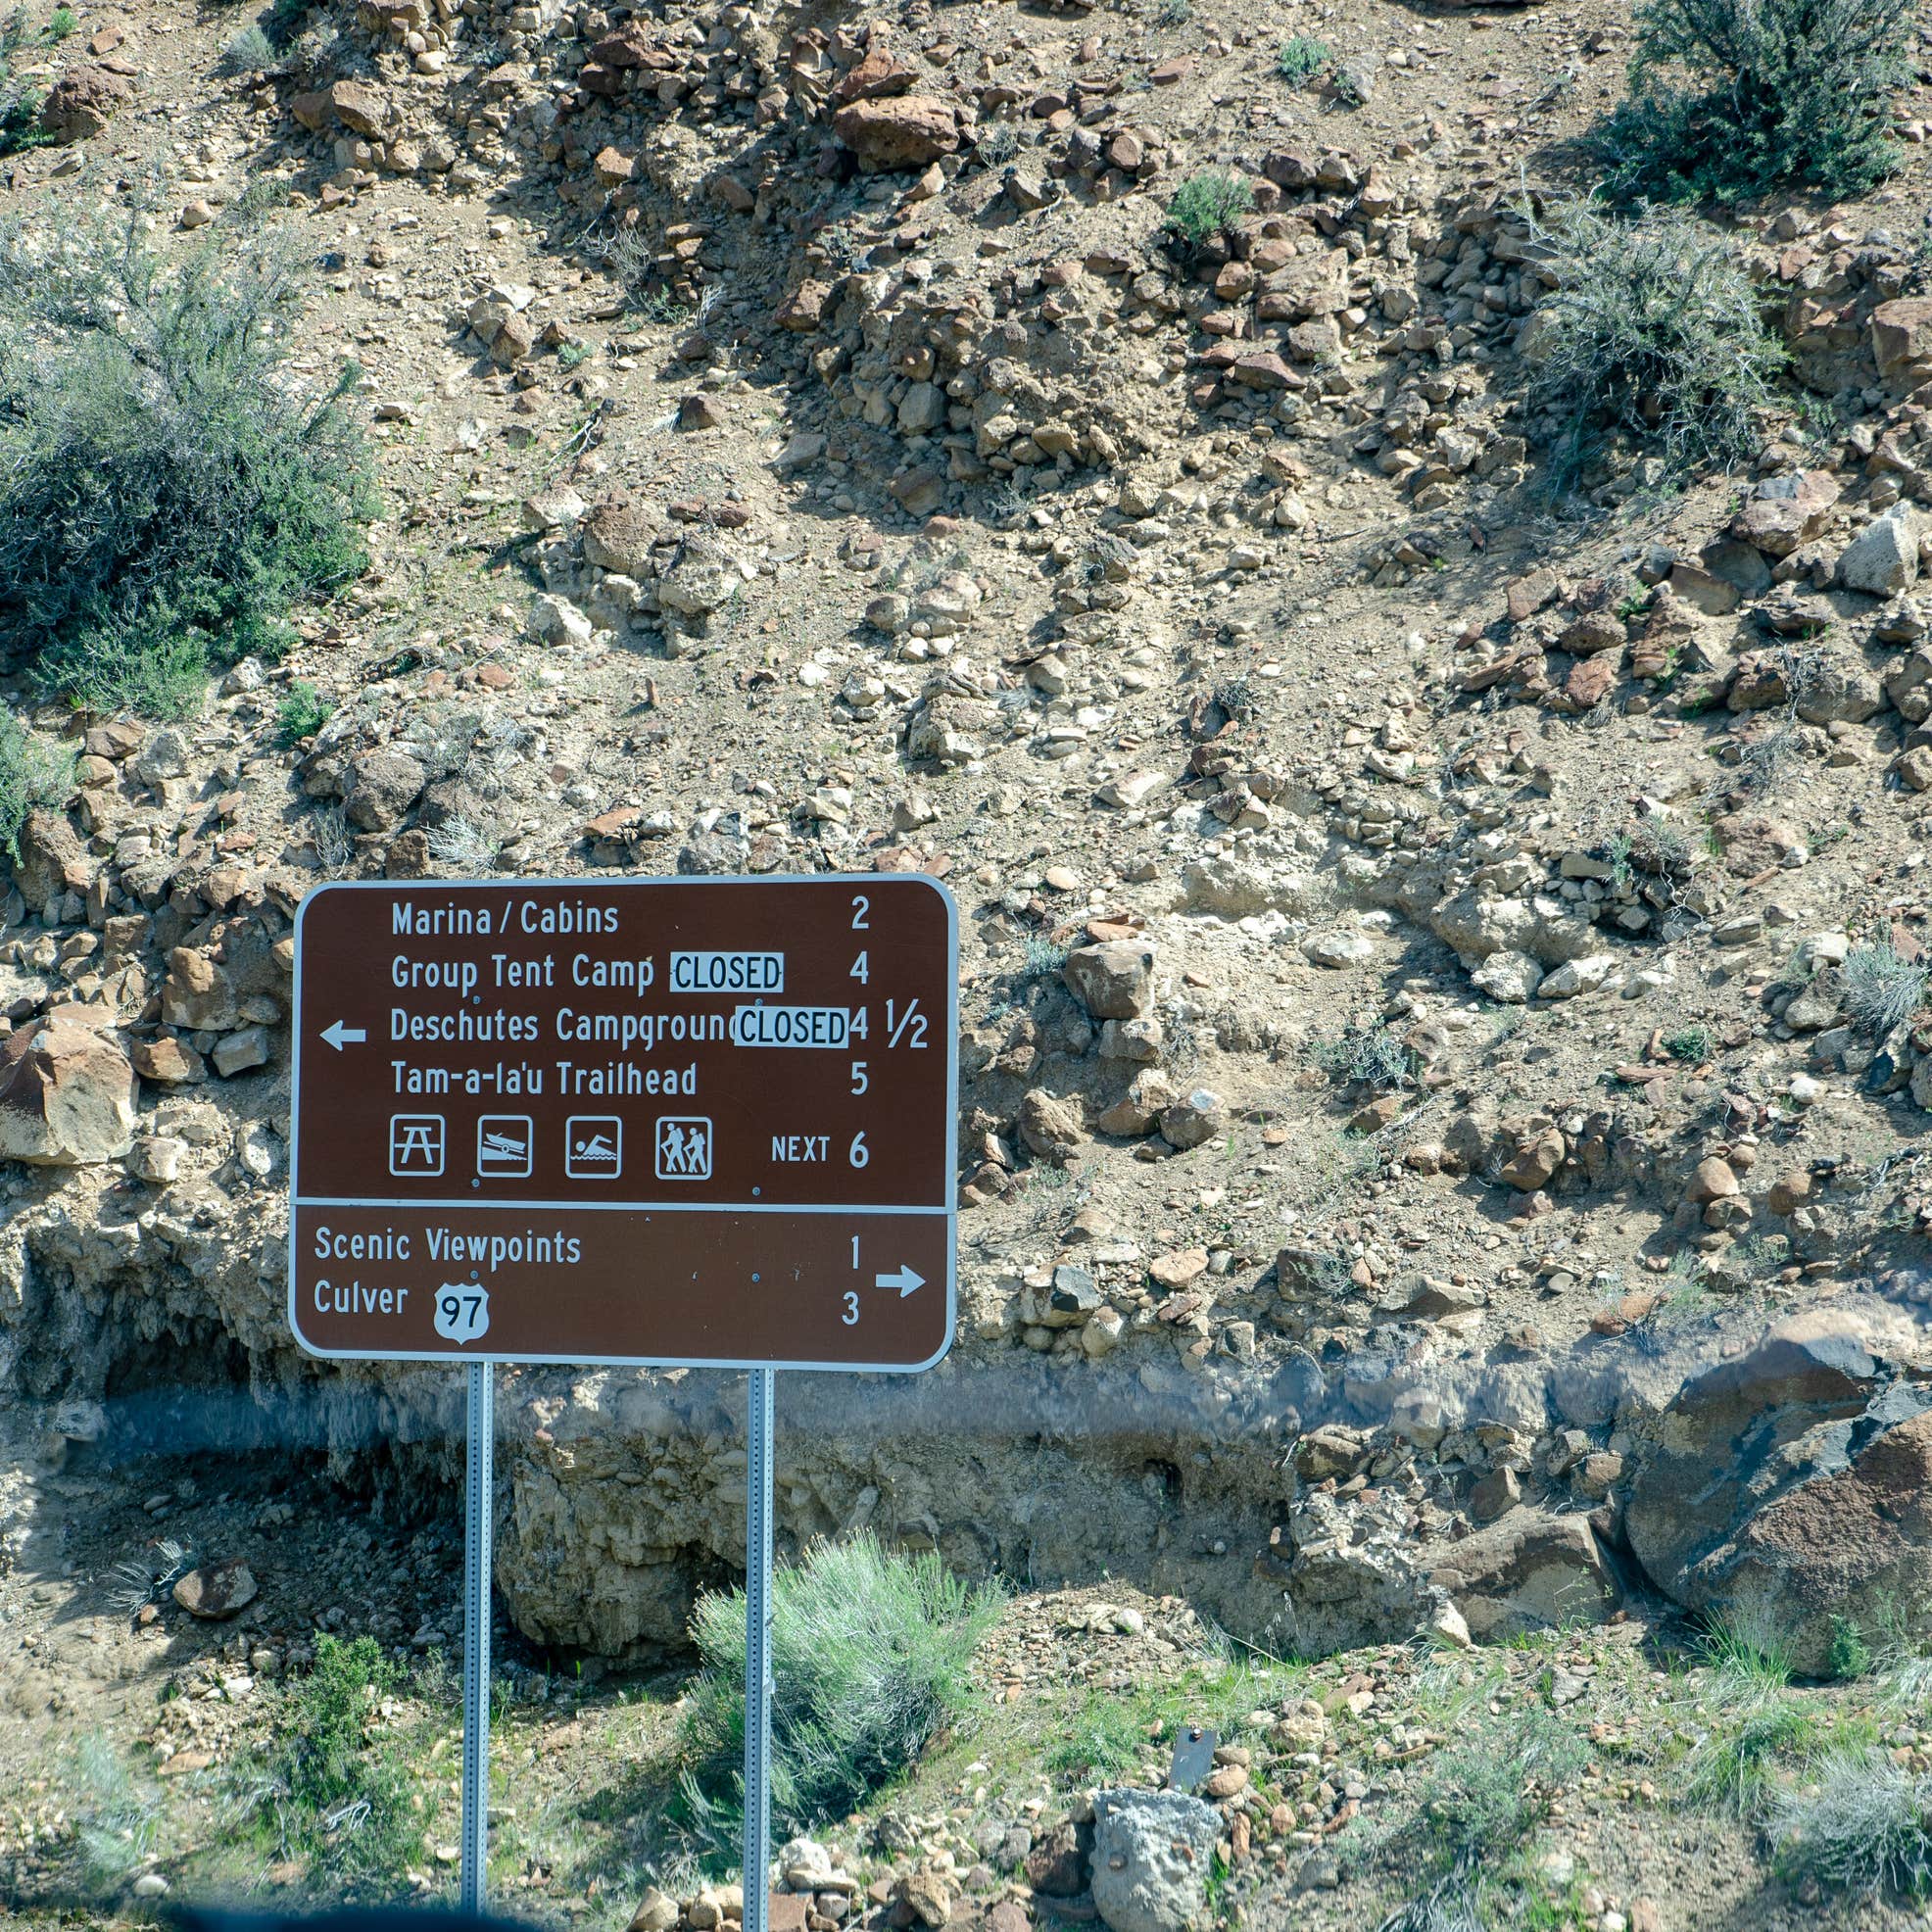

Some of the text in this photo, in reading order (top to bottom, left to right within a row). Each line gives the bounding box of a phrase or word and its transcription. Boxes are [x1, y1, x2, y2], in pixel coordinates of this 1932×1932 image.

[392, 903, 491, 935] Marina
[520, 900, 619, 935] Cabins
[851, 895, 869, 930] 2
[392, 953, 654, 998] Group Tent Camp
[675, 955, 781, 990] CLOSED
[849, 950, 869, 985] 4
[391, 1008, 539, 1041] Deschutes
[740, 1010, 846, 1043] CLOSED
[848, 1006, 869, 1040] 4
[391, 1060, 697, 1095] Tam-a-la'u Trailhead
[850, 1061, 868, 1095] 5
[771, 1131, 869, 1169] NEXT 6
[314, 1226, 581, 1273] Scenic Viewpoints
[850, 1234, 859, 1270] 1
[314, 1280, 409, 1314] Culver
[441, 1295, 483, 1328] 97
[842, 1290, 859, 1326] 3
